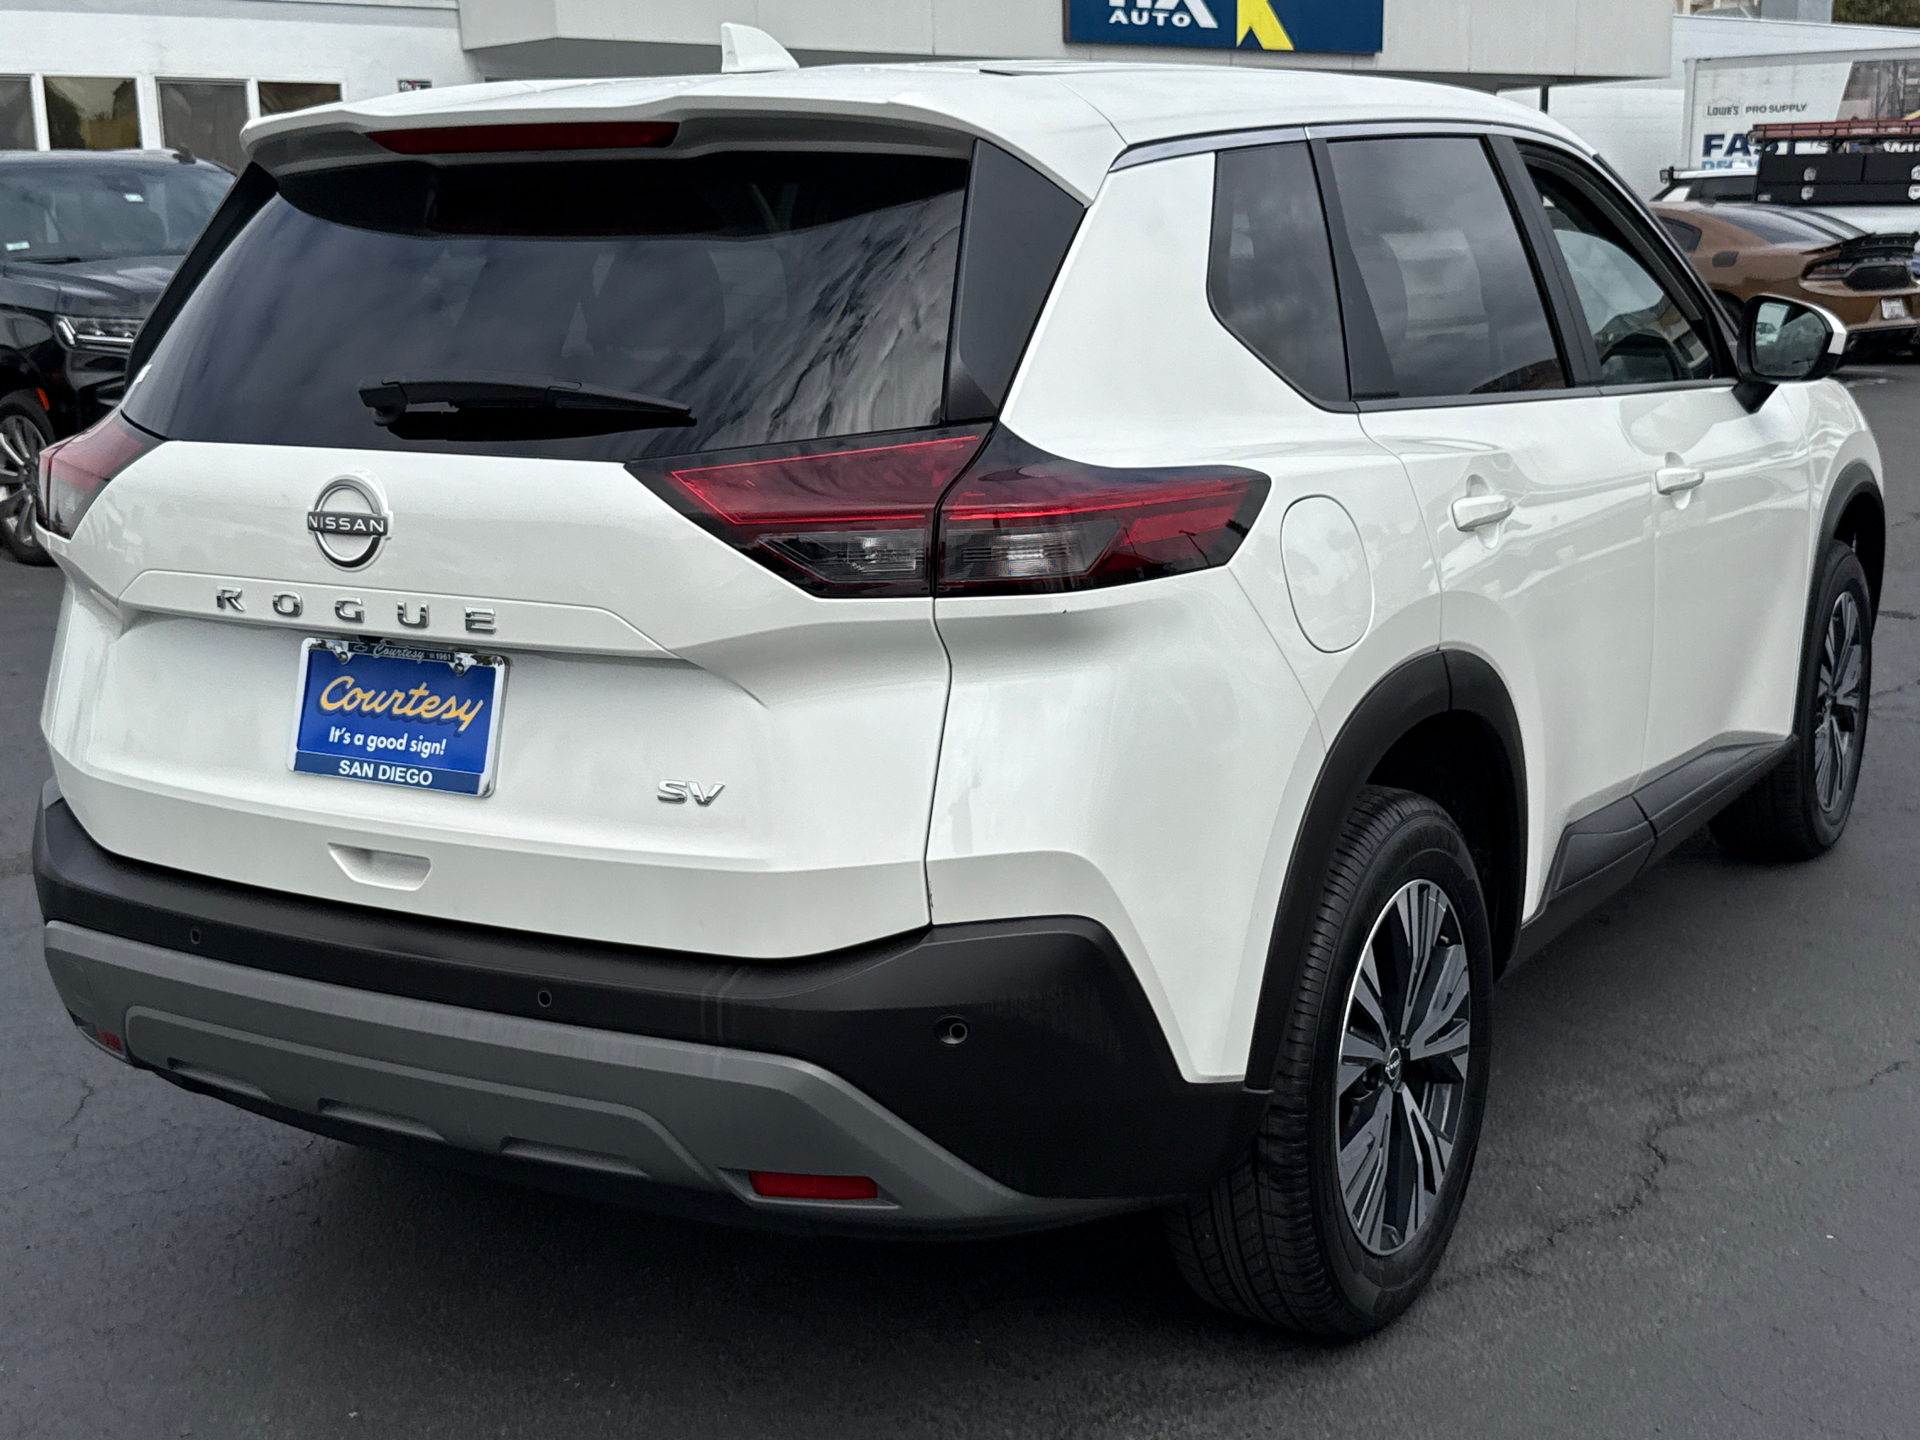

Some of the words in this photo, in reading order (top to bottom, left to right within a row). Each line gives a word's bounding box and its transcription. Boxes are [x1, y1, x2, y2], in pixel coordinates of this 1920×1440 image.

[1108, 8, 1192, 28] AUTO
[1745, 105, 1767, 114] PRO
[1768, 103, 1807, 113] SUPPLY
[308, 514, 385, 533] NISSAN
[216, 584, 497, 634] ROGUE
[373, 640, 424, 664] Courtesy
[320, 675, 484, 732] Courtesy
[328, 726, 351, 744] It's
[354, 733, 364, 746] a
[366, 732, 408, 752] good
[409, 735, 447, 758] sign!
[338, 760, 374, 778] SAN
[378, 764, 433, 786] DIEGO
[657, 779, 725, 807] SV
